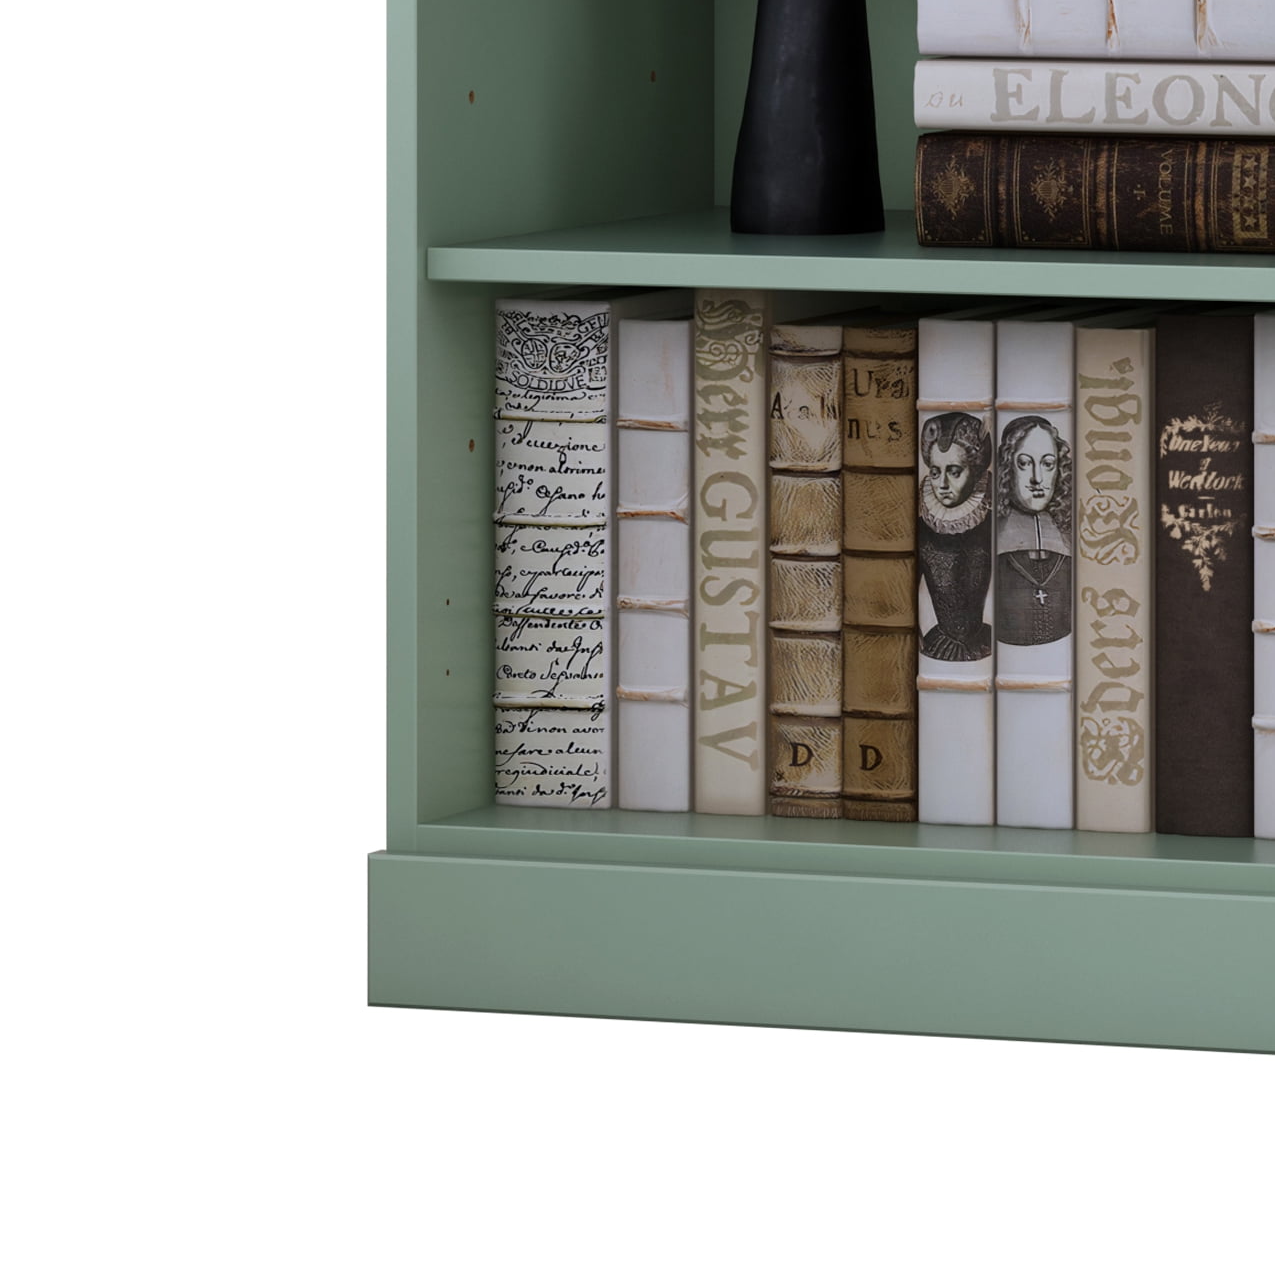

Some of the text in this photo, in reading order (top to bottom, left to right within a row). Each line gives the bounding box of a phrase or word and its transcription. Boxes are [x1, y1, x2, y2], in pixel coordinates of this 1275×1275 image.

[1159, 148, 1174, 236] VOLUME
[1169, 436, 1200, 453] One
[1168, 470, 1245, 492] Wedlock
[699, 471, 761, 772] GUSTAV
[789, 742, 813, 768] D
[859, 745, 883, 771] D
